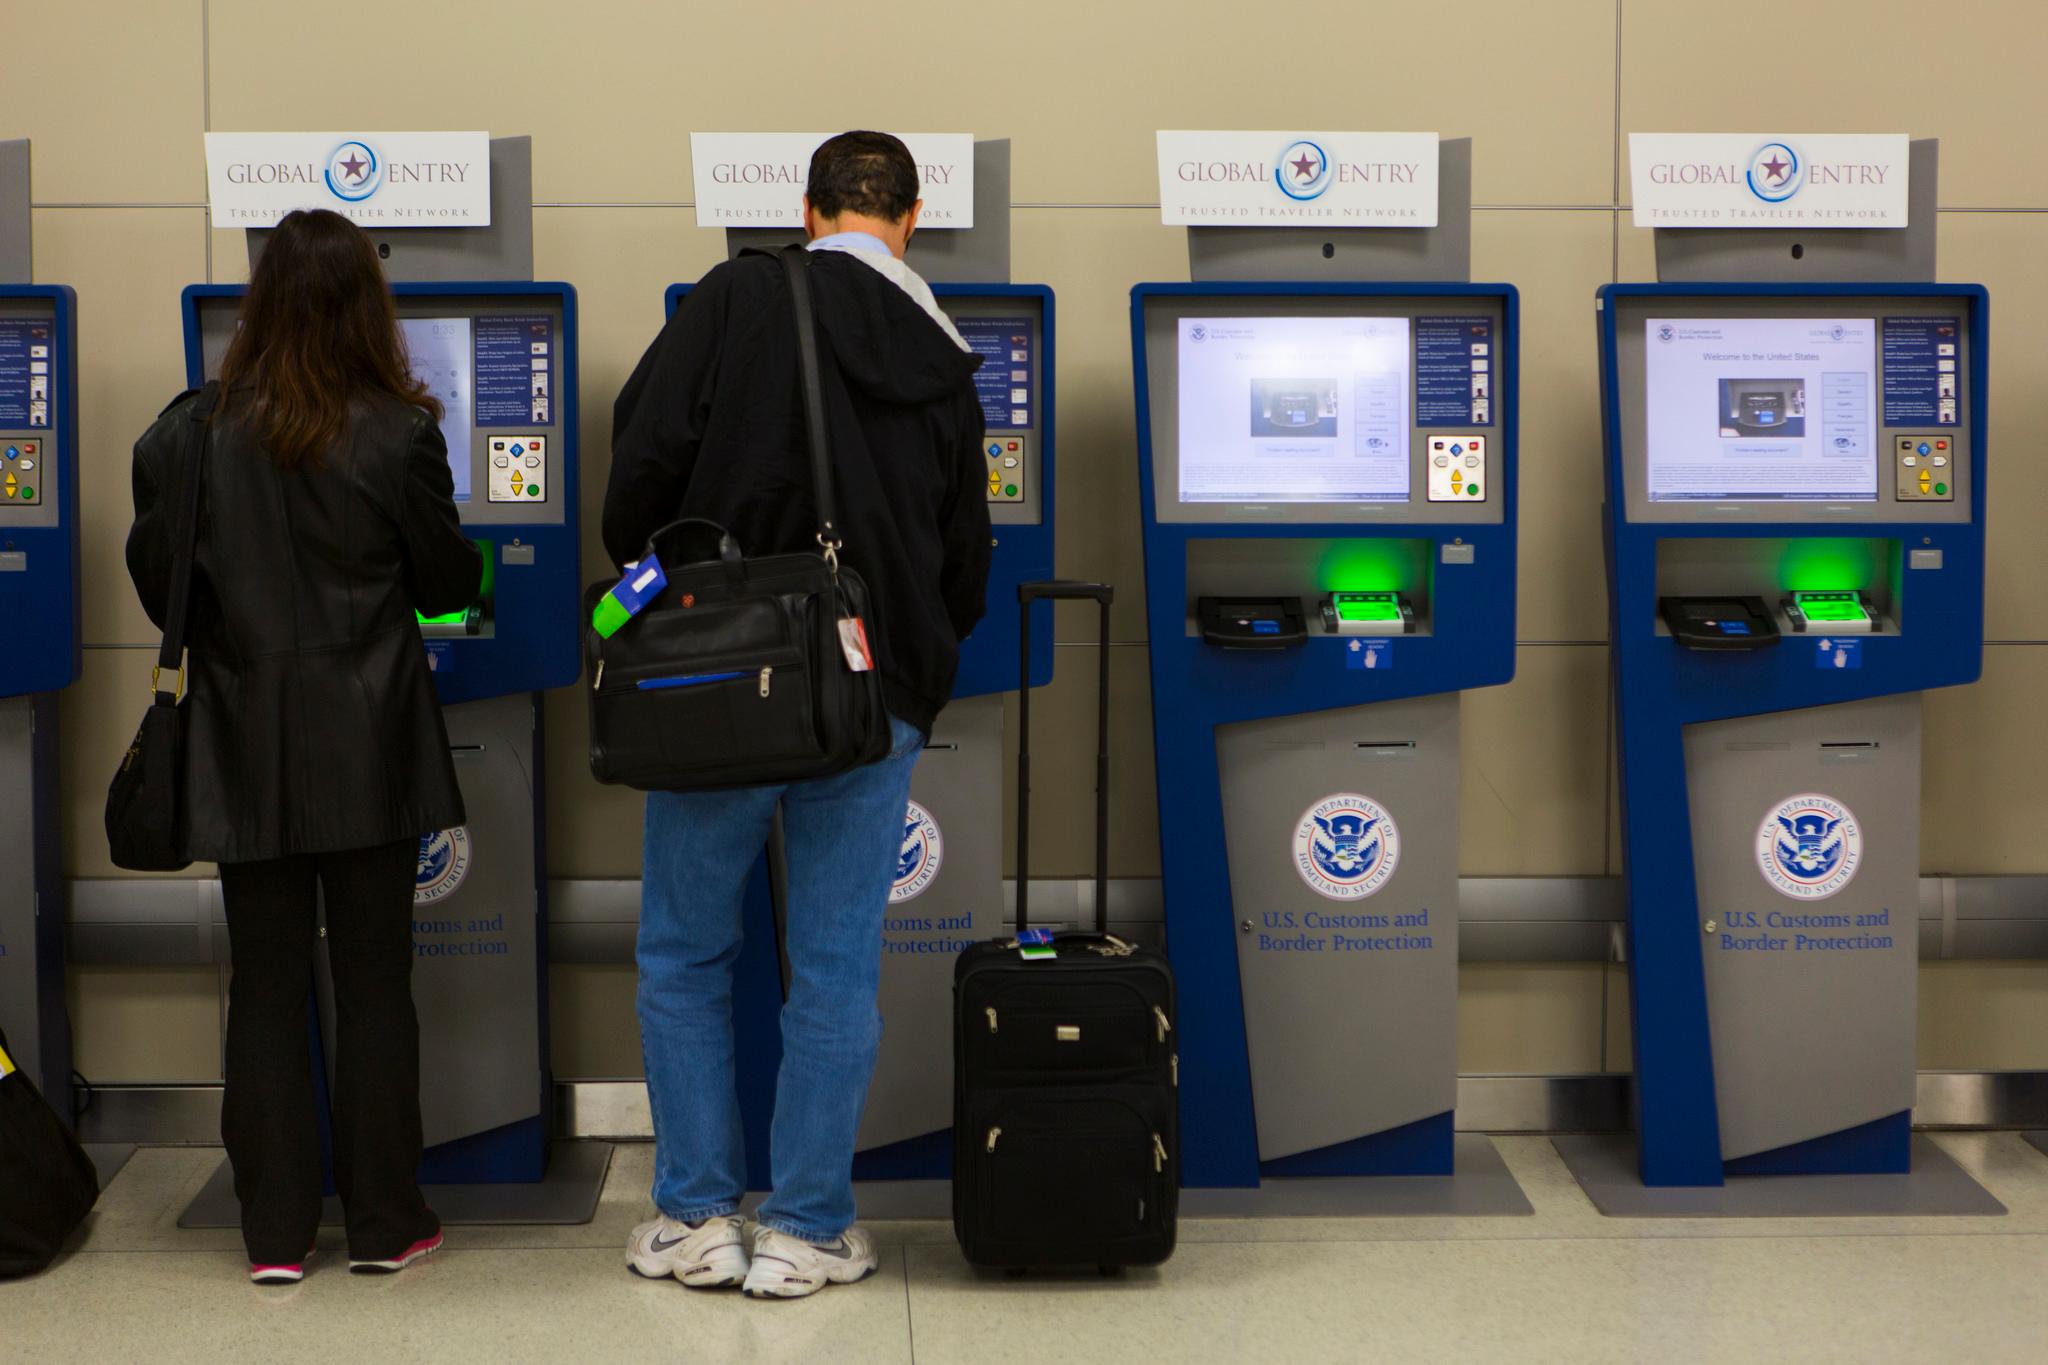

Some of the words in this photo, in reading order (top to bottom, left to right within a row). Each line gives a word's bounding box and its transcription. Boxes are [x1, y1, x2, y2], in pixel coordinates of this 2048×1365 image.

[227, 163, 319, 184] GLOBAL
[389, 163, 469, 183] ENTRY
[712, 163, 804, 184] GLOBAL
[1178, 162, 1270, 182] GLOBAL
[1339, 163, 1419, 183] ENTRY
[1650, 164, 1741, 184] GLOBAL
[1809, 164, 1889, 184] ENTRY
[230, 208, 289, 218] TRUSTE
[394, 208, 470, 217] NETWORK
[715, 208, 784, 218] TRUSTED
[1180, 206, 1248, 216] TRUSTED
[1259, 207, 1333, 216] TRAVELER
[1344, 208, 1417, 217] NETWORK
[1651, 208, 1720, 218] TRUSTED
[1730, 209, 1804, 218] TRAVELER
[1814, 209, 1888, 218] NETWORK
[1703, 352, 1740, 361] Welcome
[1742, 353, 1751, 361] to
[1753, 353, 1765, 361] the
[1767, 352, 1793, 361] United
[1795, 352, 1820, 361] States
[1315, 798, 1387, 824] DEPARTMENT
[1383, 824, 1394, 839] OF
[1779, 798, 1848, 824] DEPARTMENT
[1847, 824, 1857, 839] OF
[454, 828, 466, 843] OF
[926, 827, 937, 842] OF
[425, 855, 466, 900] SECURITY
[895, 854, 937, 897] SECURITY
[1299, 852, 1349, 895] HOMELAND
[1353, 852, 1394, 894] SECURITY
[1762, 852, 1812, 895] HOMELAND
[1815, 851, 1857, 894] SECURITY
[411, 919, 462, 934] toms
[467, 914, 504, 933] and
[883, 918, 932, 931] toms
[938, 912, 972, 929] and
[1263, 911, 1298, 928] U.S.
[1304, 911, 1388, 928] Customs
[1393, 908, 1429, 927] and
[1724, 911, 1760, 928] U.S.
[1766, 911, 1850, 928] Customs
[1856, 908, 1889, 926] and
[1259, 934, 1325, 951] Border
[1333, 933, 1433, 951] Protection
[1720, 933, 1788, 951] Border
[1795, 933, 1893, 950] Protection
